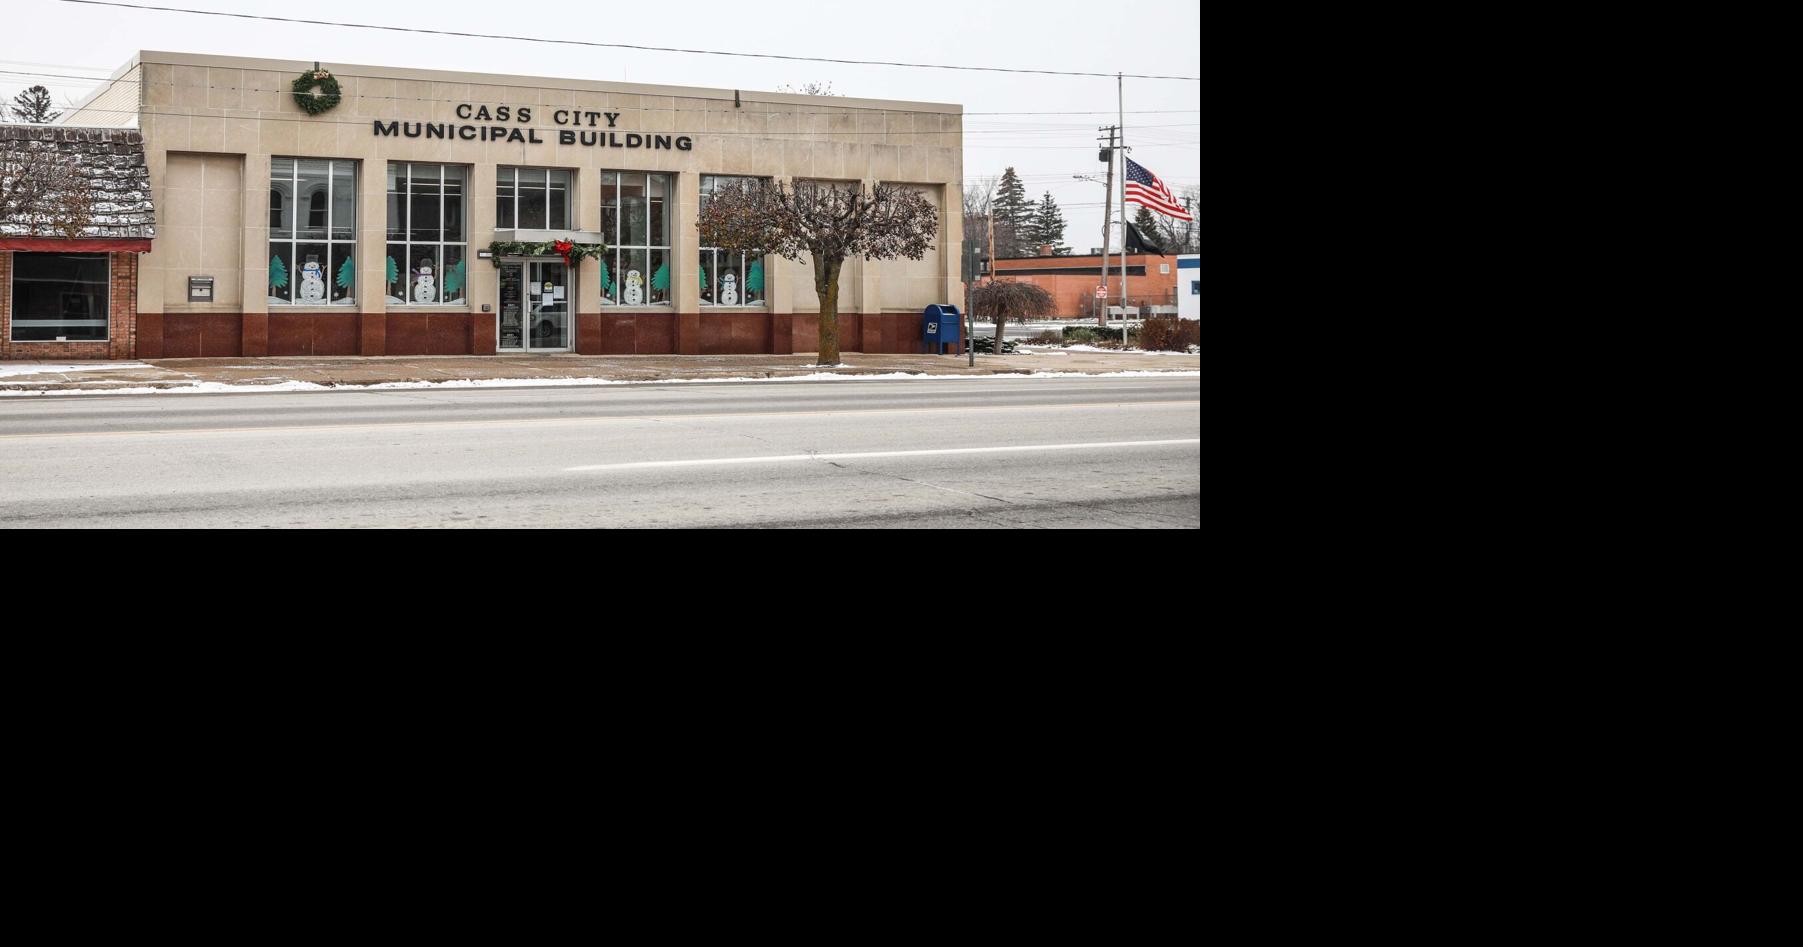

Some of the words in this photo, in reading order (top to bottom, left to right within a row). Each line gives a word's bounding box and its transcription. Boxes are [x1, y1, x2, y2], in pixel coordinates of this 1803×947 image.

[456, 104, 532, 123] CASS
[553, 110, 620, 127] CITY
[373, 120, 543, 144] MUNICIPAL
[559, 130, 693, 151] BUILDING
